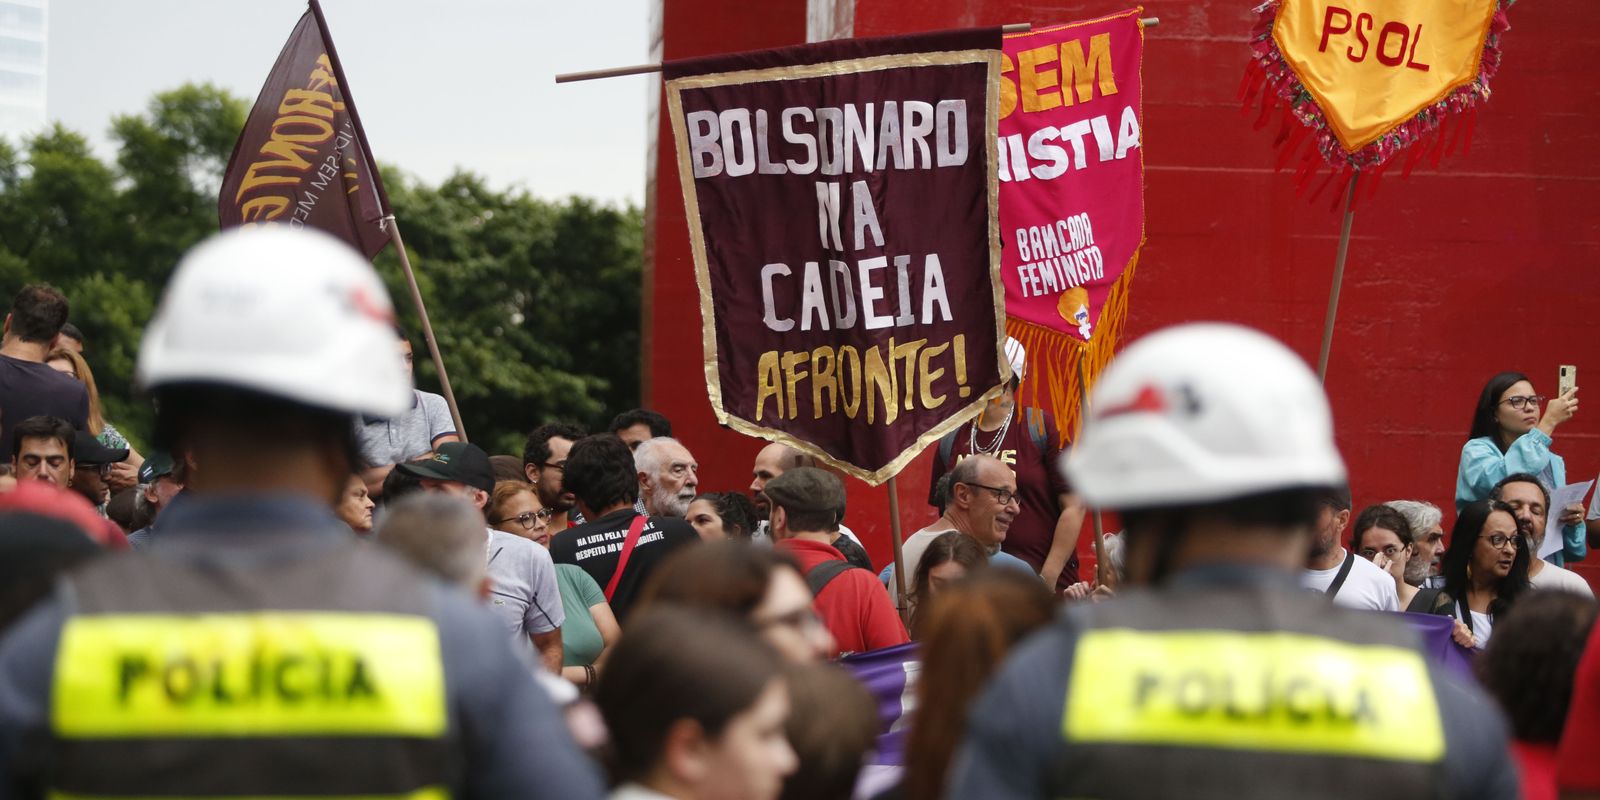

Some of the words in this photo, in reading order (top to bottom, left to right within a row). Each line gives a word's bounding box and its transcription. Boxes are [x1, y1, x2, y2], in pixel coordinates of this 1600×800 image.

[1318, 6, 1430, 72] PSOL
[999, 32, 1118, 120] SEM
[687, 99, 968, 178] BOLSONARO
[815, 180, 885, 251] NA
[1016, 212, 1094, 262] BANCADA
[761, 253, 953, 332] CADEIA
[1017, 245, 1104, 298] FEMINISTA
[755, 333, 971, 426] AFRONTE!
[575, 545, 607, 561] RESPEITO
[607, 543, 617, 553] AO
[576, 537, 588, 547] NA
[587, 533, 605, 544] LUTA
[604, 530, 622, 541] PELA
